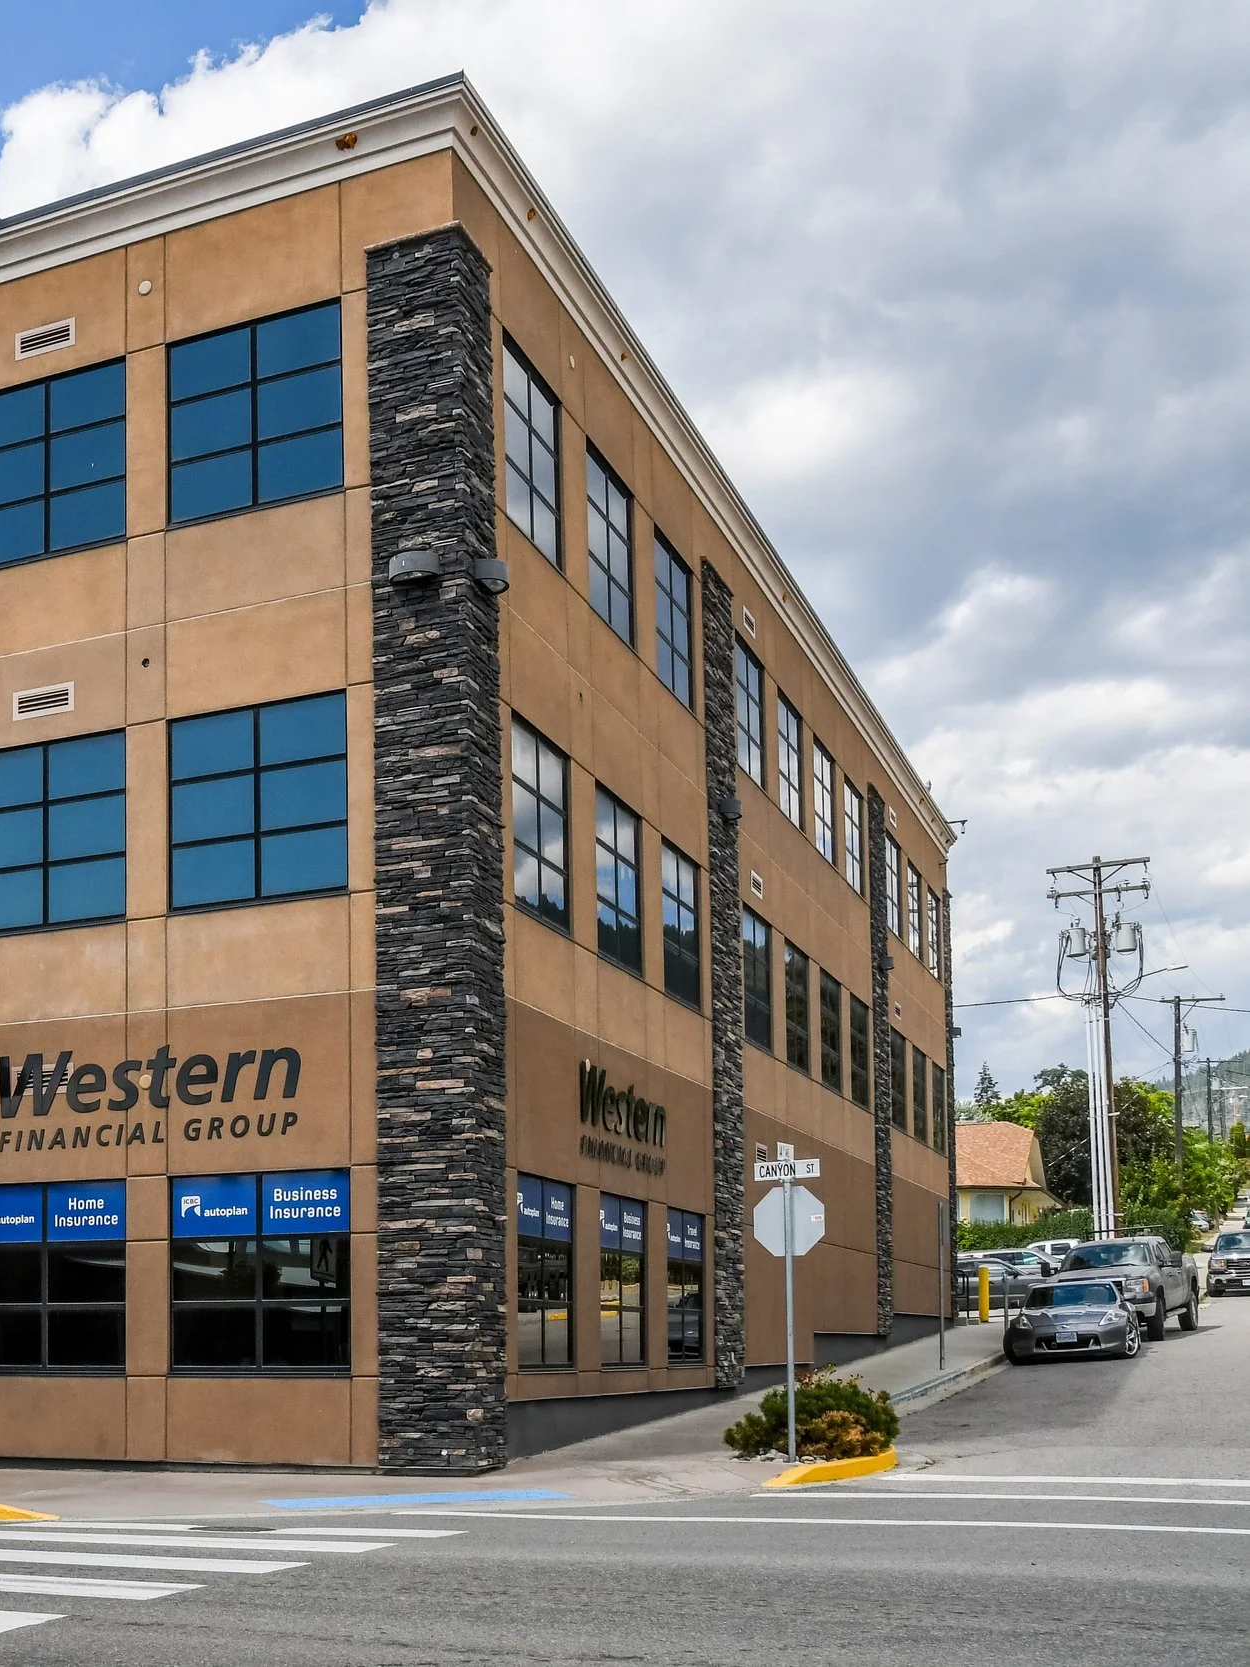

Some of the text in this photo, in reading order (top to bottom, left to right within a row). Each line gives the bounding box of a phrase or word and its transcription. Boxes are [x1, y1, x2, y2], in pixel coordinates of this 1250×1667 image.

[579, 1060, 667, 1148] Western
[183, 1111, 298, 1142] GROUP
[759, 1163, 815, 1179] CANYON ST
[273, 1187, 338, 1202] Business
[68, 1197, 105, 1211] Home
[550, 1196, 565, 1211] Home
[203, 1206, 248, 1218] autoplan
[269, 1205, 341, 1219] Insurance
[623, 1211, 641, 1226] Business
[54, 1214, 119, 1228] Insurance
[545, 1212, 569, 1228] Insurance
